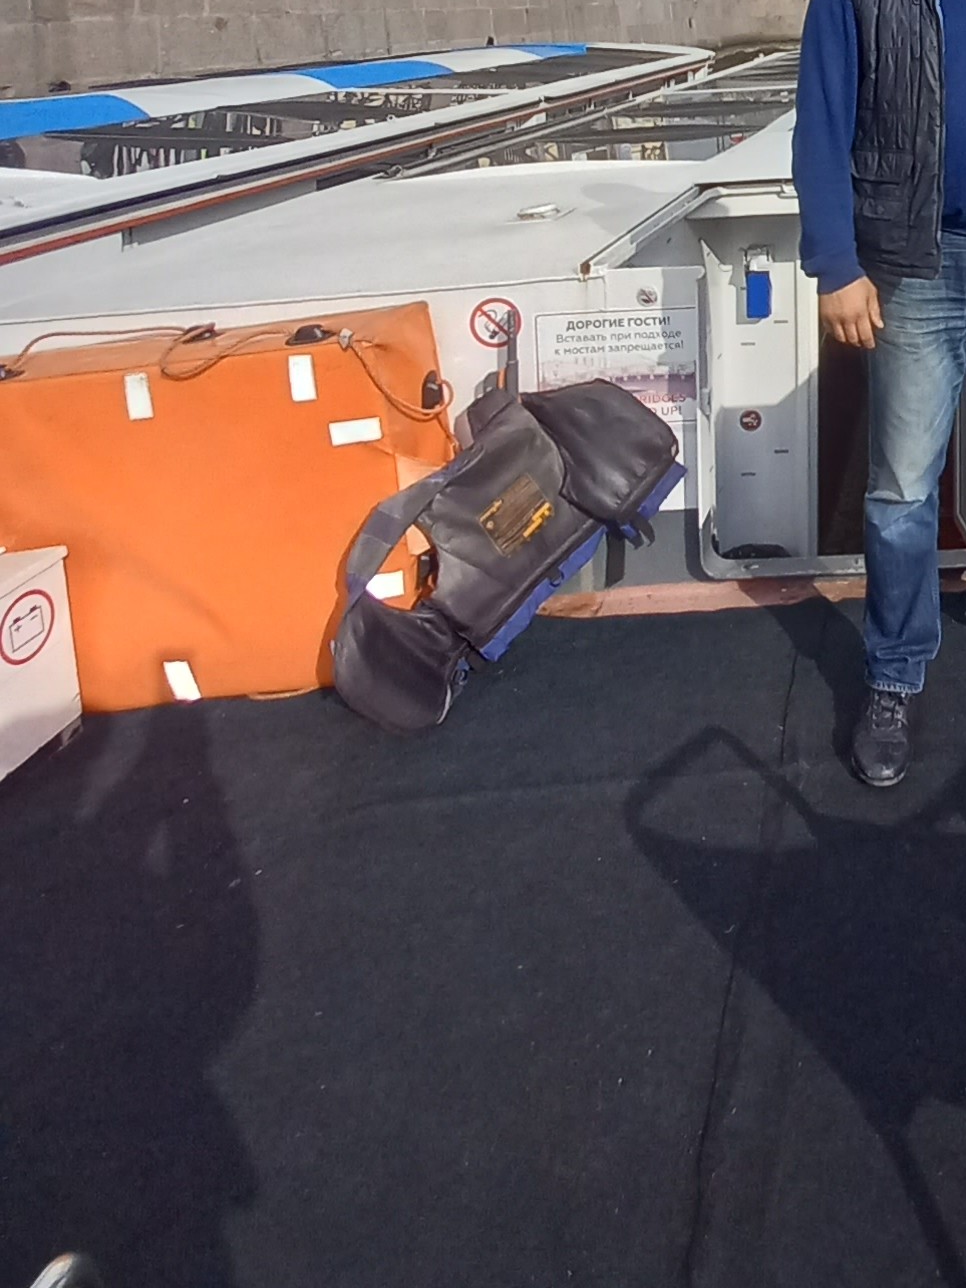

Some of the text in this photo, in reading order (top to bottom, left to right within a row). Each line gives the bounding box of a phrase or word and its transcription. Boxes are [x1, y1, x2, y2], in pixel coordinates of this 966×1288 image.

[566, 316, 671, 331] ДОРОГИЕ ГОСТИ!
[556, 330, 682, 344] Вставать при подходе
[563, 345, 605, 355] мостам
[607, 340, 684, 353] запрещается!
[639, 392, 686, 404] RIDGES
[661, 405, 683, 416] UP!
